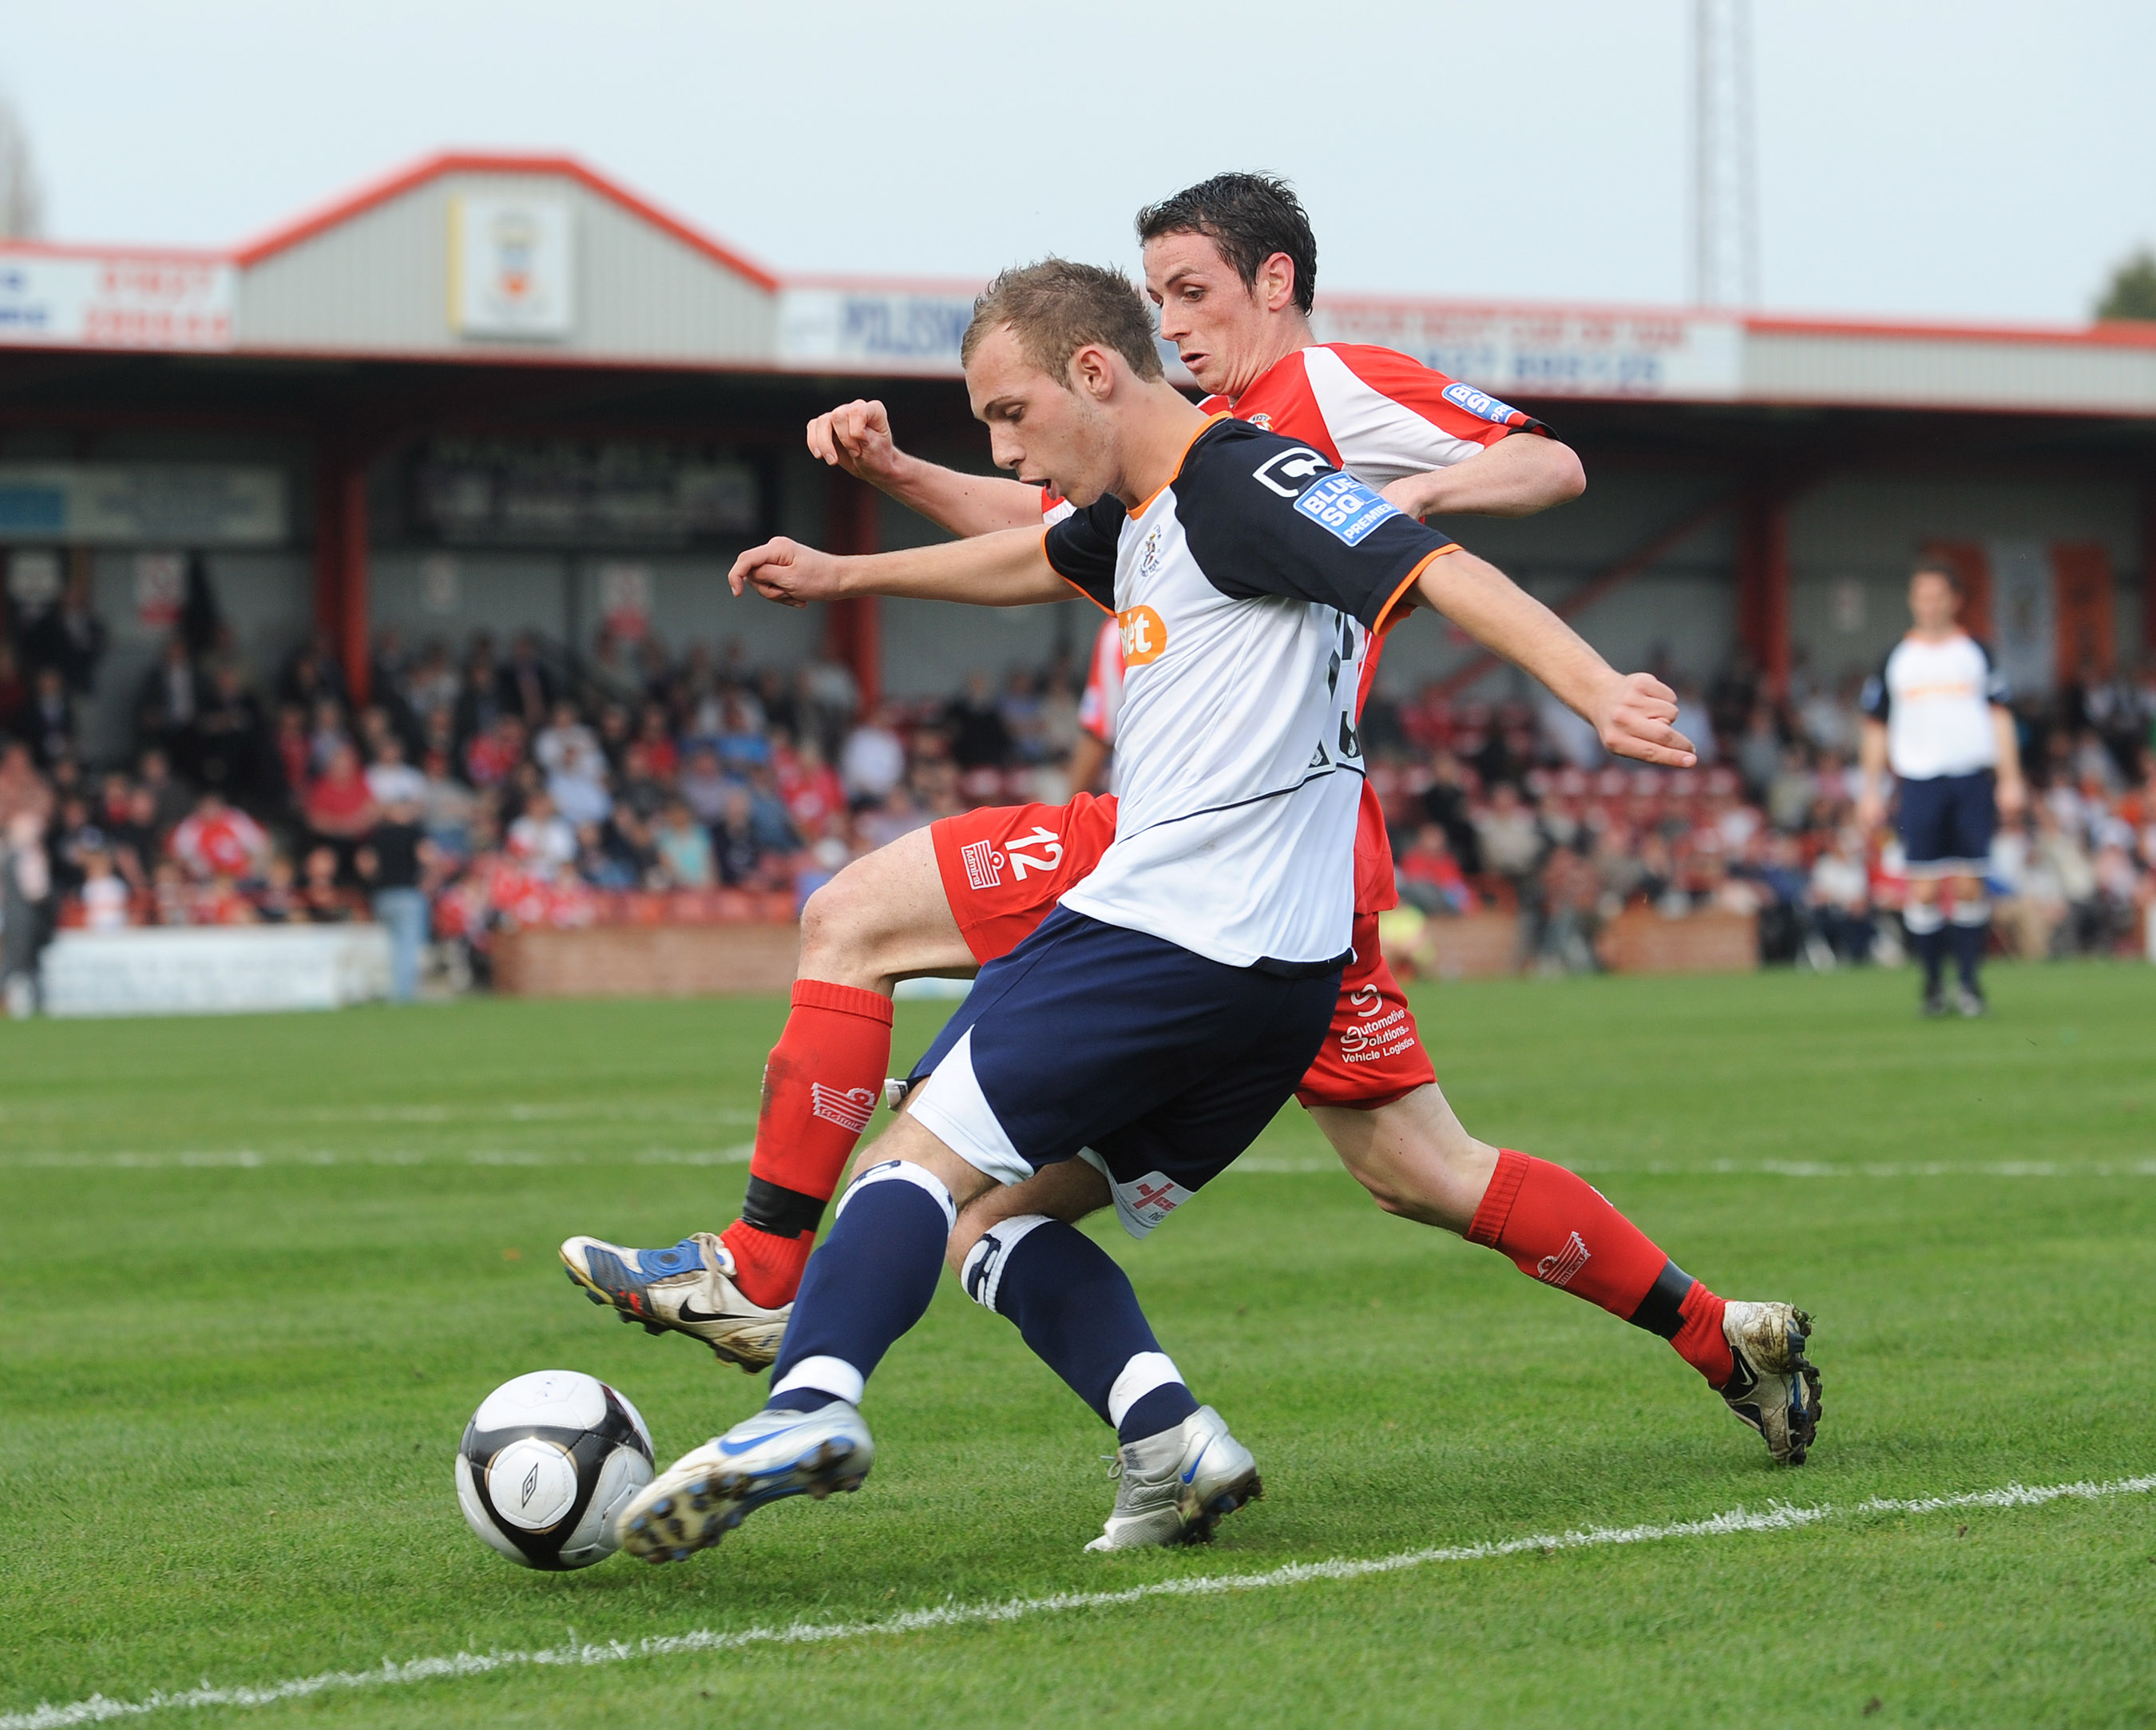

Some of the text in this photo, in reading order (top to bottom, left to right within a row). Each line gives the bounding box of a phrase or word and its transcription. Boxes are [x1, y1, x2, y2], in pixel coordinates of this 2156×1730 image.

[1302, 478, 1361, 515] BLUE
[1320, 494, 1366, 527] SQ
[1342, 503, 1395, 540] PREMIER
[965, 848, 984, 887] Admiral
[1005, 826, 1064, 882] 12
[1342, 1038, 1415, 1063] Vehicle Logistics
